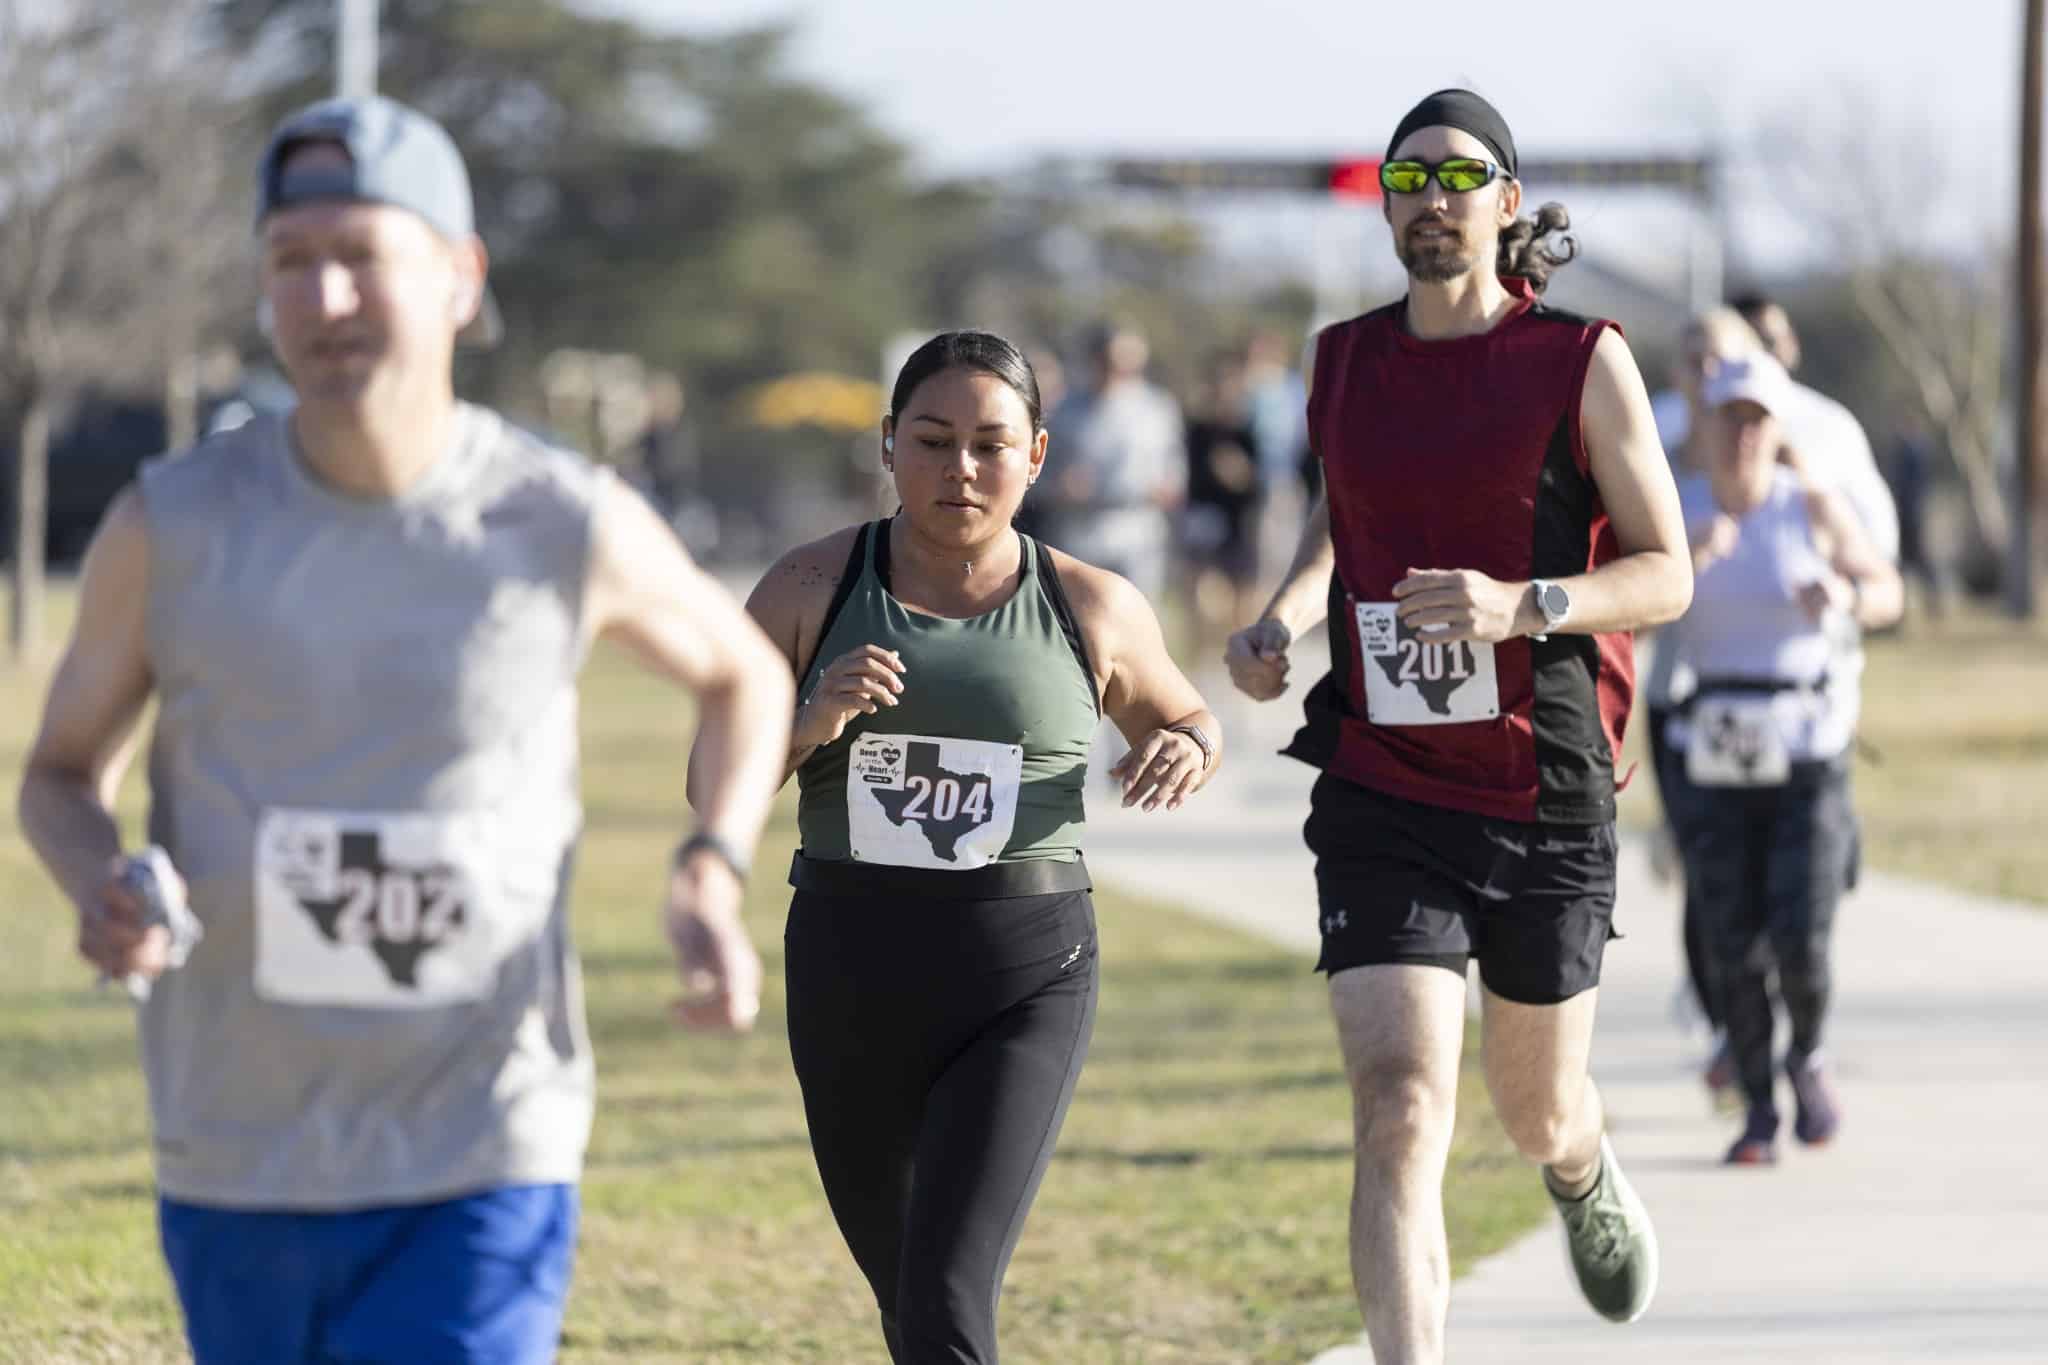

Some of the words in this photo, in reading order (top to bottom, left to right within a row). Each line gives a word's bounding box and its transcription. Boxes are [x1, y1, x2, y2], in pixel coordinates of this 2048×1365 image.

[1398, 639, 1470, 681] 201
[902, 775, 988, 823] 204
[335, 867, 464, 945] 202
